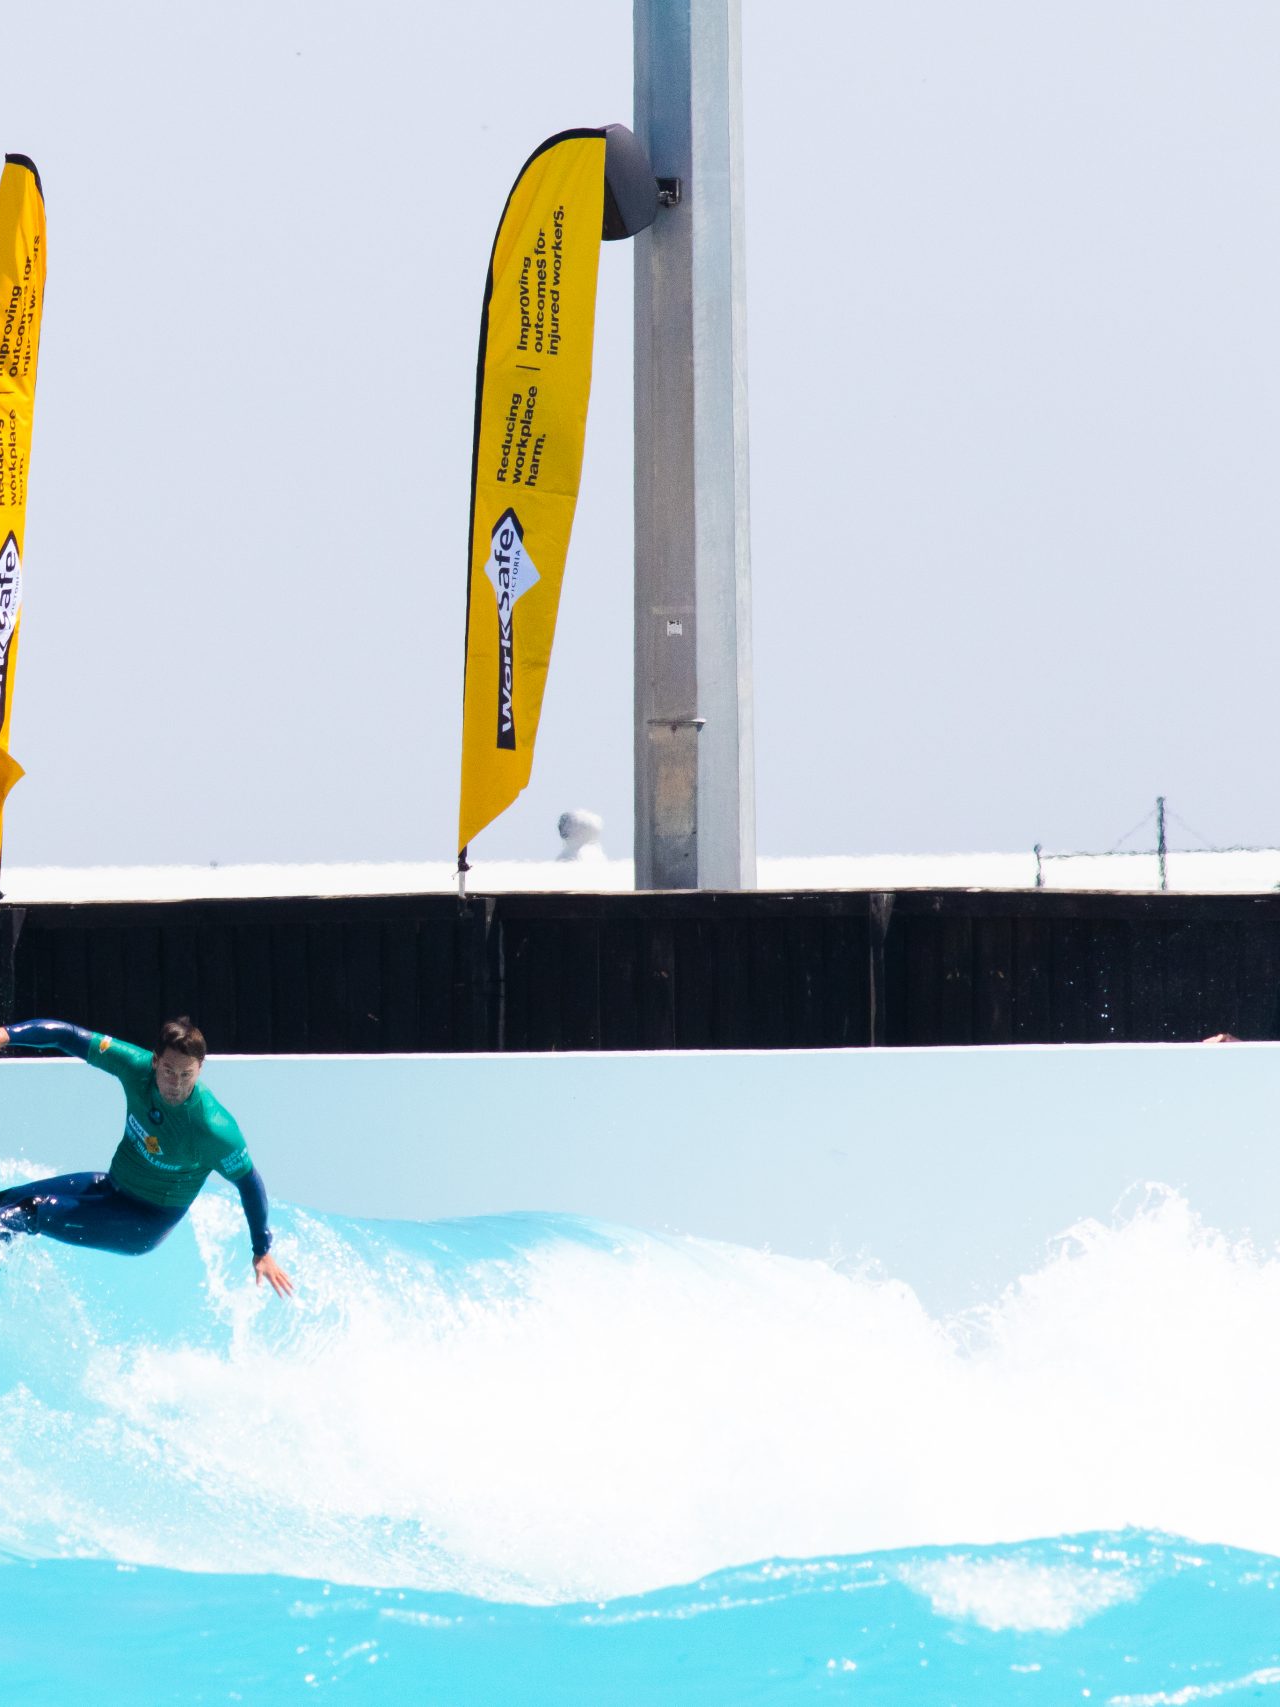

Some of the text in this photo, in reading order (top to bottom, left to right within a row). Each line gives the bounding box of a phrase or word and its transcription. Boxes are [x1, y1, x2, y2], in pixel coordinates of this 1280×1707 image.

[517, 257, 532, 351] Improving
[534, 228, 548, 354] outcomes for
[546, 205, 564, 356] injured workers.
[8, 409, 18, 507] workplace
[497, 393, 523, 483] Reducing
[511, 385, 538, 485] workplace
[525, 433, 547, 487] harm.
[510, 549, 521, 599] VICTORIA
[494, 528, 515, 733] WorkSafe
